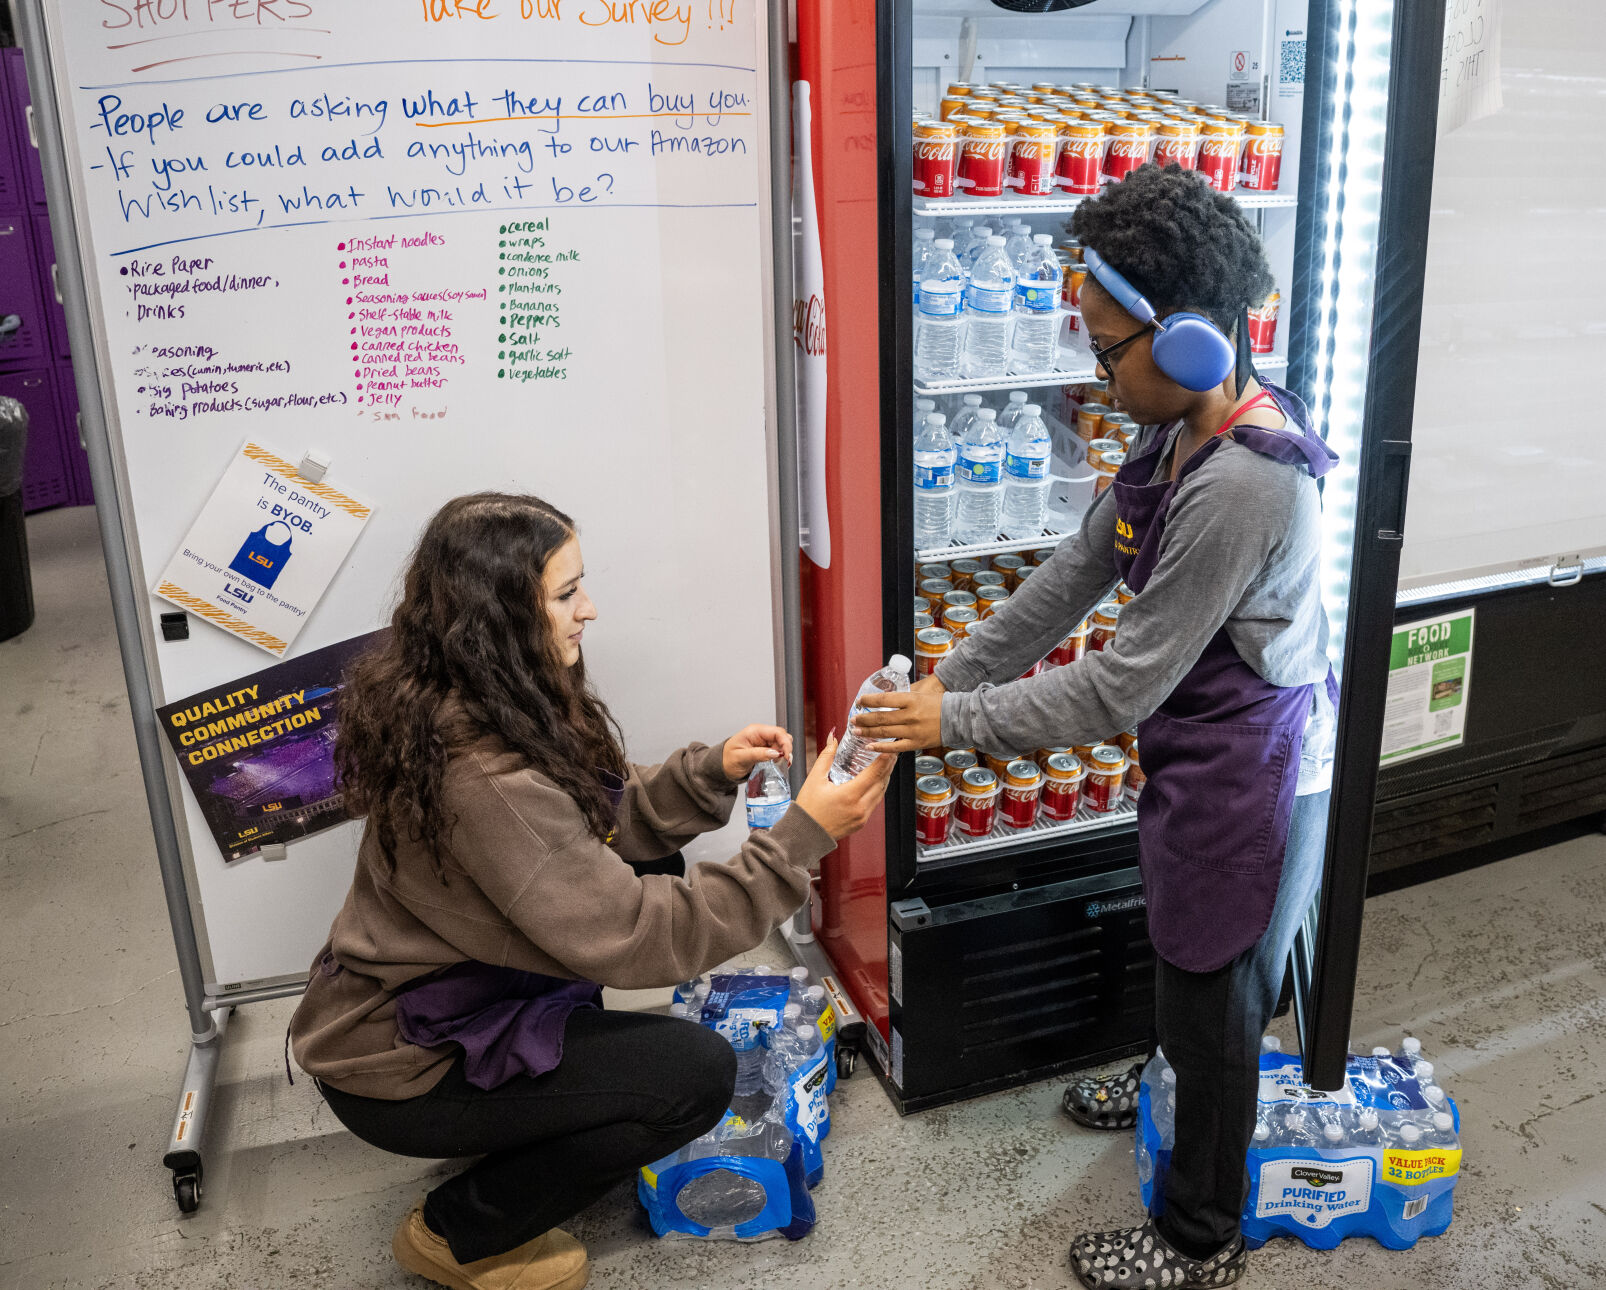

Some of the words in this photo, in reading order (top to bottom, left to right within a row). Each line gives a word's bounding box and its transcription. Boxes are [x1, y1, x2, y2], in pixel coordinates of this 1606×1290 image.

[206, 103, 267, 123] are
[290, 93, 387, 135] asking
[402, 90, 478, 118] what
[492, 89, 561, 133] they
[578, 92, 627, 112] can
[649, 83, 693, 129] buy
[152, 156, 208, 191] you
[225, 145, 306, 168] could
[321, 137, 384, 160] add
[407, 132, 534, 175] anything
[545, 136, 572, 158] to
[590, 136, 640, 154] our
[651, 130, 746, 156] Amazon
[279, 186, 365, 210] what
[504, 176, 533, 199] it
[552, 174, 614, 202] be?
[347, 234, 398, 253] Instant
[401, 231, 445, 248] noodles
[172, 256, 213, 275] Paper
[134, 279, 190, 300] packaged
[354, 274, 389, 288] Bread
[137, 304, 185, 322] Drinks
[510, 299, 559, 312] Bananas
[401, 324, 451, 337] products
[151, 346, 218, 361] easoning
[404, 352, 422, 362] red
[429, 353, 465, 365] beans
[509, 348, 543, 365] garlic
[406, 364, 440, 376] beans
[411, 377, 448, 388] butter
[262, 472, 287, 495] The
[288, 489, 331, 520] pantry
[257, 496, 269, 510] is
[270, 504, 313, 535] BYOB.
[1116, 512, 1133, 539] SU
[248, 551, 274, 569] LSU
[183, 548, 204, 566] Bring
[204, 561, 223, 575] your
[223, 572, 240, 583] own
[241, 579, 256, 592] bag
[257, 588, 265, 596] to
[266, 592, 279, 603] the
[224, 583, 254, 603] LSU
[216, 595, 230, 605] Food
[230, 601, 247, 615] Pantry
[1408, 622, 1451, 648] FOOD
[1408, 648, 1449, 666] NETWORK
[170, 685, 259, 727] QUALITY
[179, 690, 305, 746] COMMUNITY
[188, 707, 322, 766] CONNECTION
[263, 802, 282, 812] LSU
[238, 827, 258, 838] LSU
[1389, 1156, 1423, 1169] VALUE
[1294, 1169, 1318, 1179] Clover
[1319, 1172, 1341, 1182] Valley
[1389, 1167, 1402, 1178] 32
[1405, 1166, 1444, 1180] BOTTLES
[1282, 1187, 1346, 1202] PURIFIED
[1265, 1201, 1323, 1212] Drinking
[1326, 1199, 1361, 1212] Water
